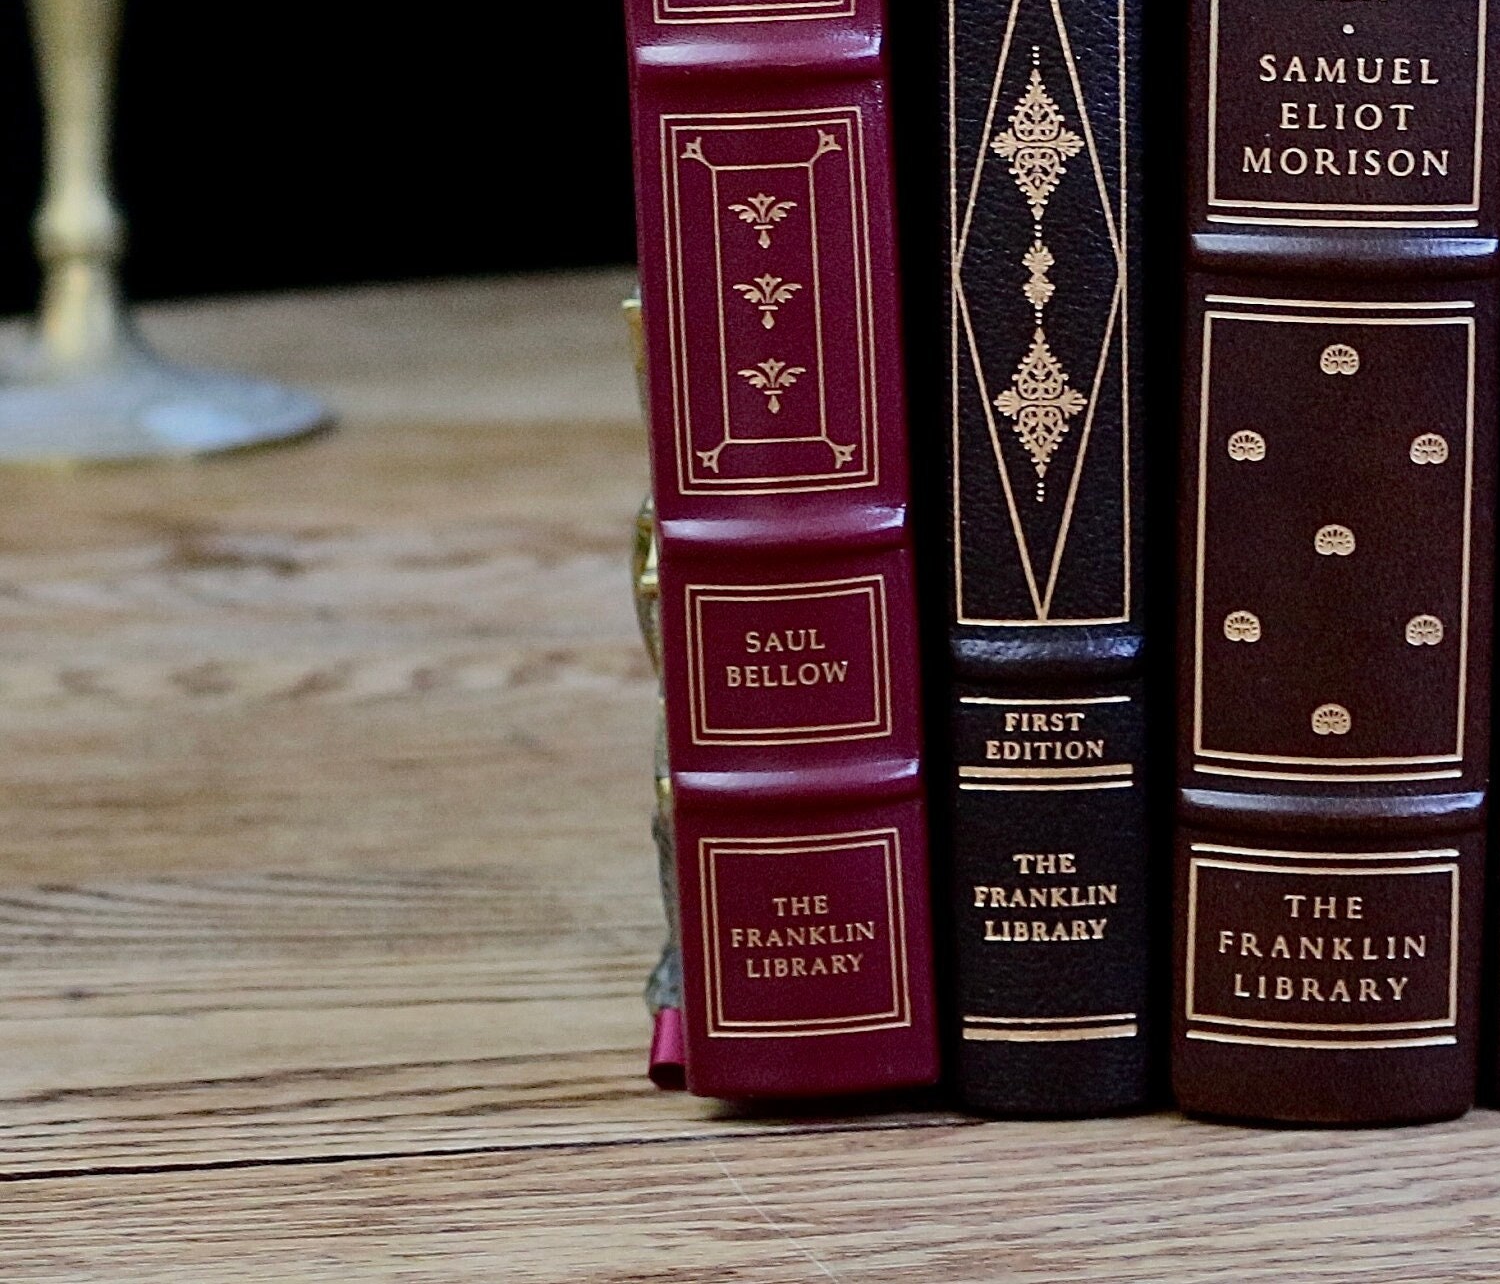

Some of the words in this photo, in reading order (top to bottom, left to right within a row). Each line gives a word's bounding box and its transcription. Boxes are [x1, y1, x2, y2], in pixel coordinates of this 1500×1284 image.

[1259, 54, 1439, 85] SAMUEL
[1279, 103, 1414, 131] ELIOT
[1242, 147, 1449, 177] MORISON
[745, 629, 825, 653] SAUL
[727, 660, 848, 687] BELLOW
[1005, 713, 1085, 733] FIRST
[986, 740, 1104, 760] EDITION
[1013, 854, 1076, 874] THE
[772, 895, 828, 916] THE
[974, 885, 1118, 907] FRANKLIN
[1284, 894, 1363, 919] THE
[731, 921, 875, 948] FRANKLIN
[984, 918, 1107, 942] LIBRARY
[1219, 931, 1426, 961] FRANKLIN
[747, 953, 864, 978] LIBRARY
[1234, 974, 1409, 1002] LIBRARY
